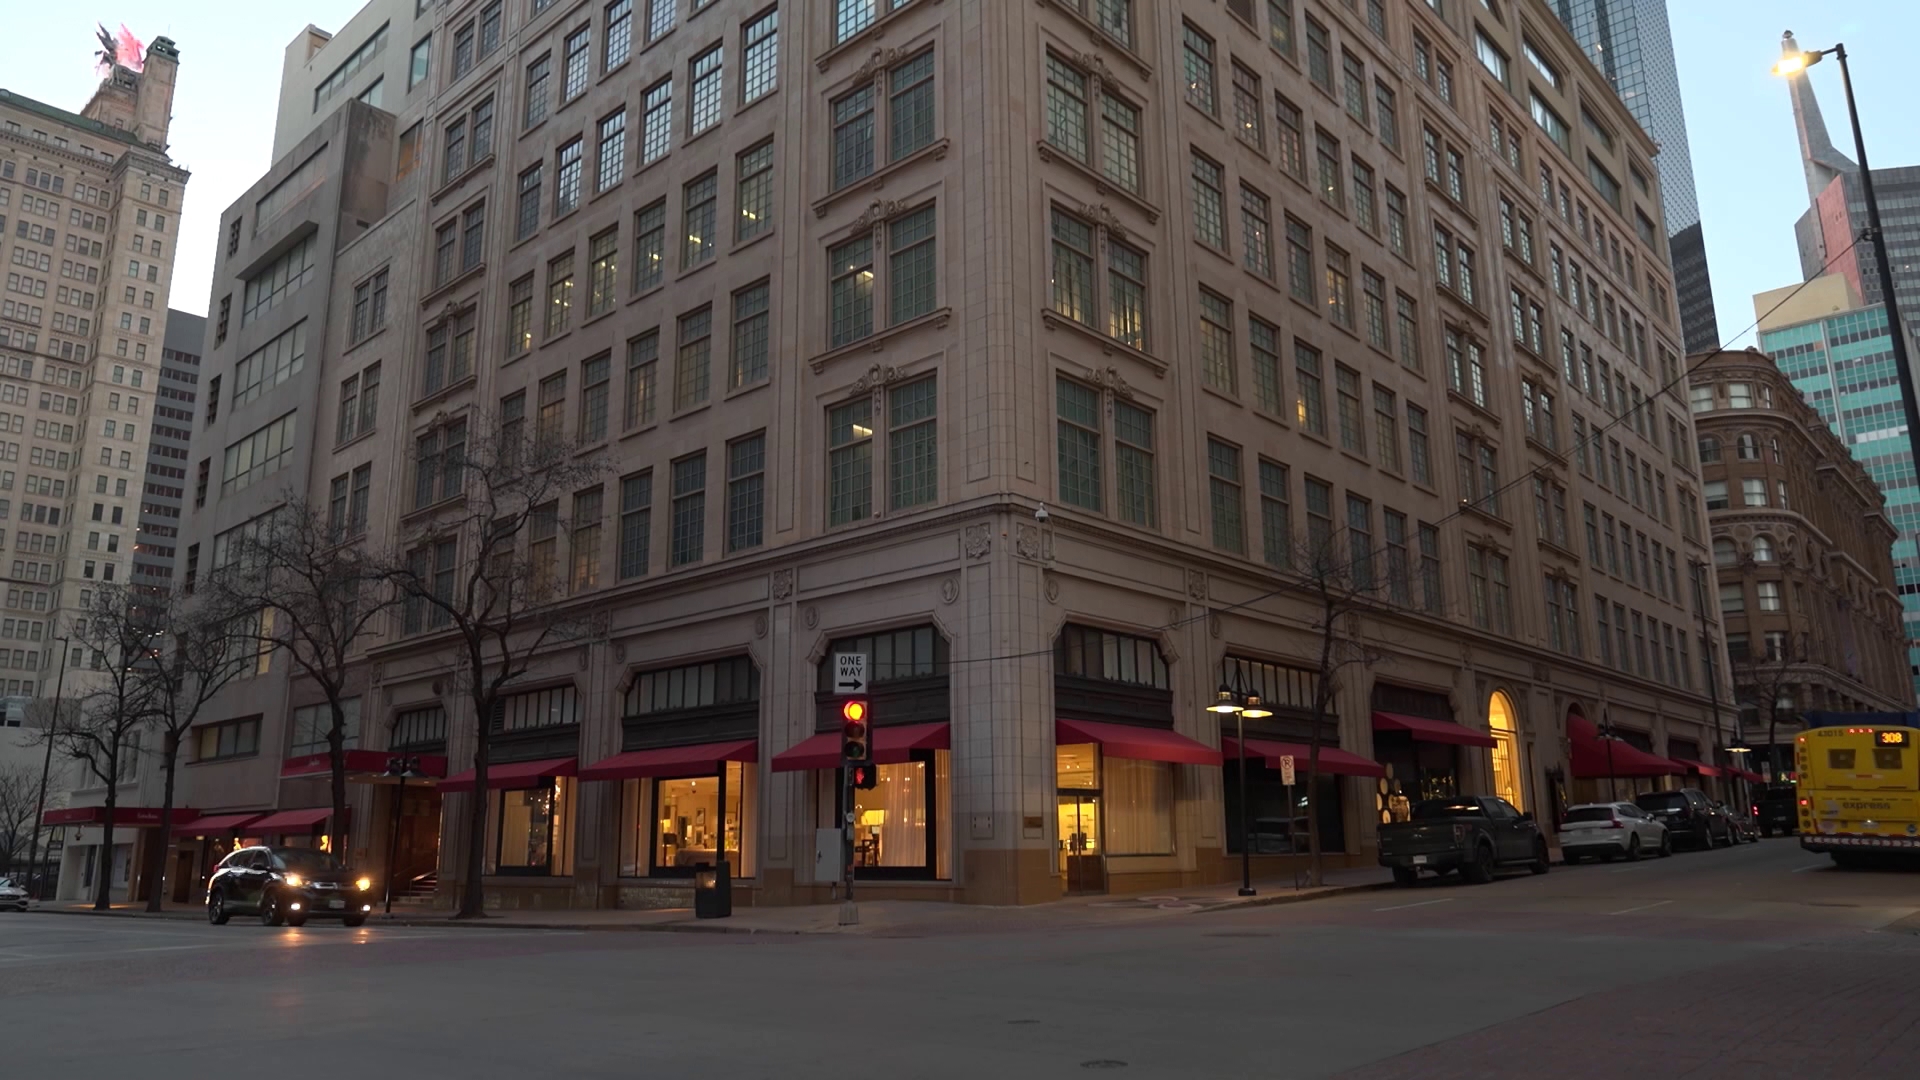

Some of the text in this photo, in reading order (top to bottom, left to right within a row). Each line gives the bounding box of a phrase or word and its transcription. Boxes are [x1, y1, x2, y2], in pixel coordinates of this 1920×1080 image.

[840, 656, 862, 666] ONE
[840, 667, 863, 677] WAY
[1881, 732, 1903, 743] 308
[1843, 802, 1890, 811] express
